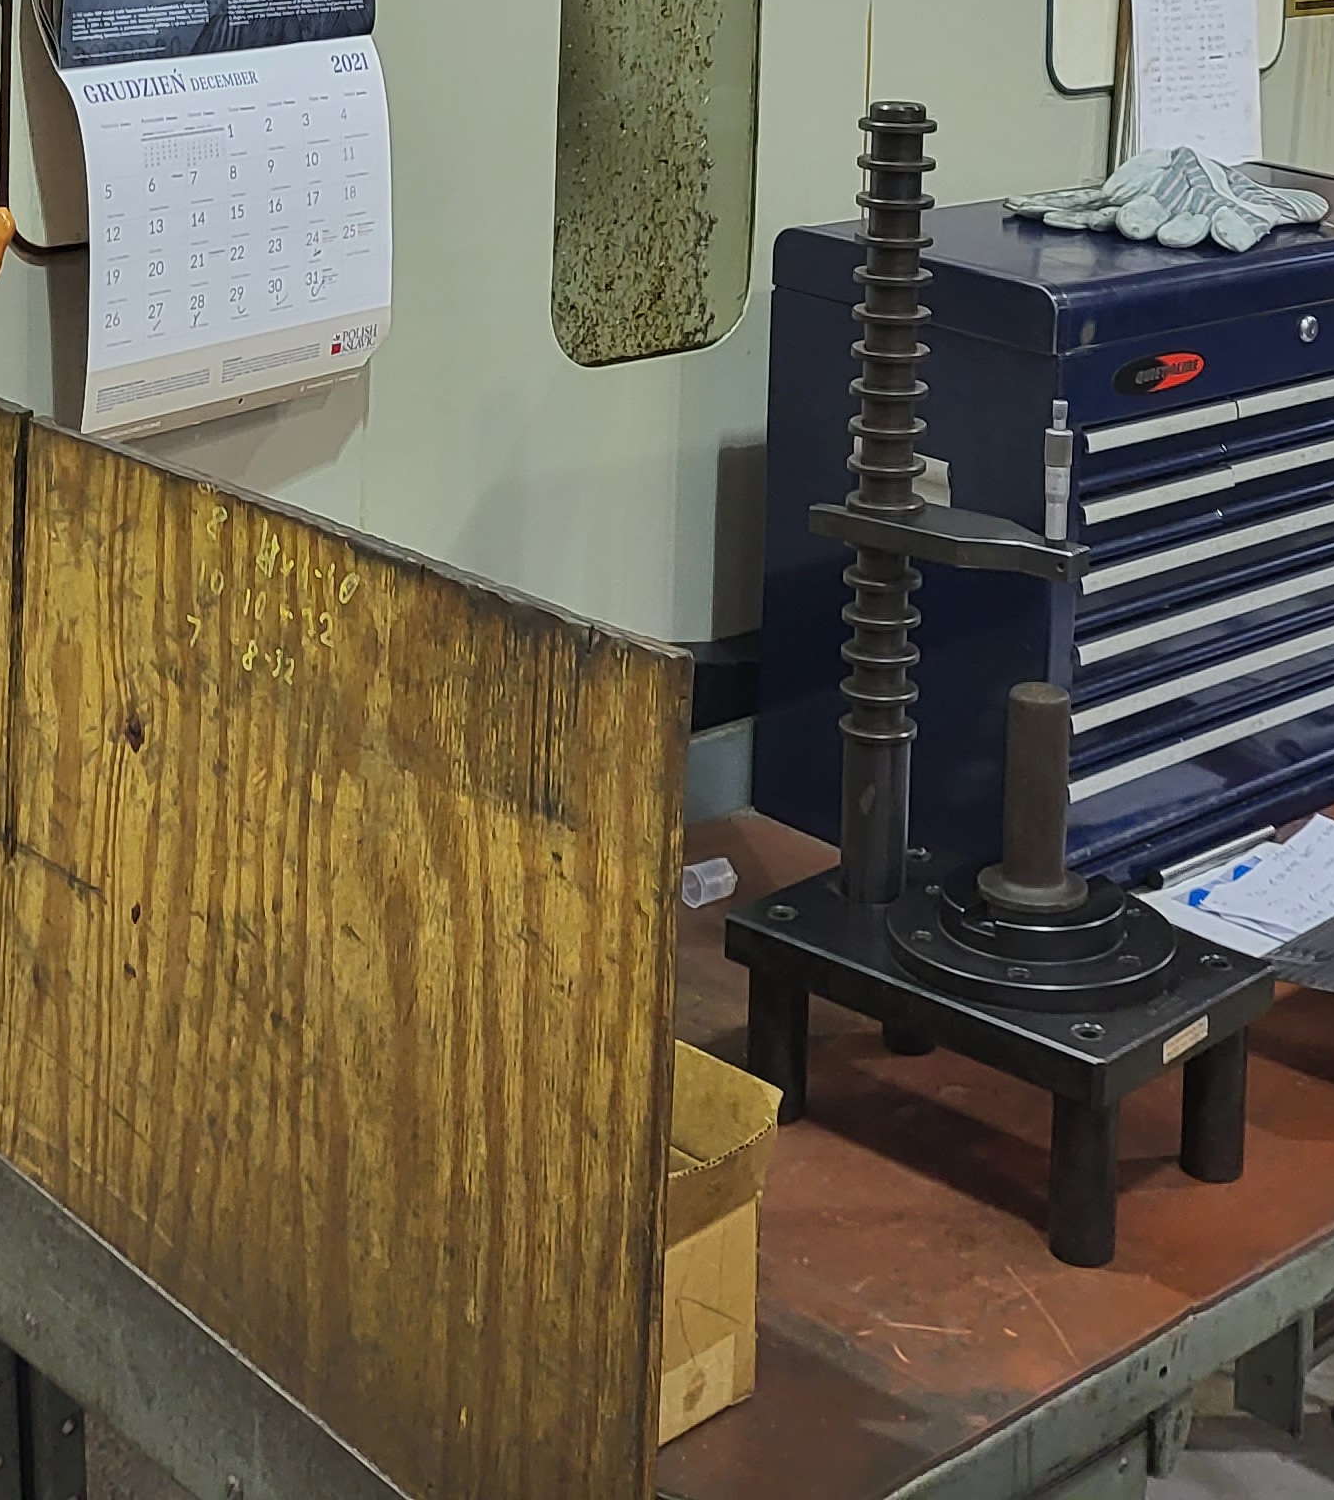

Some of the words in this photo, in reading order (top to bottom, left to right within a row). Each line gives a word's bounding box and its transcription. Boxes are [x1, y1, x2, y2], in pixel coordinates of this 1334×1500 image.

[83, 68, 186, 105] GRUDZIEŃ
[190, 70, 260, 92] DECEMBER
[330, 51, 370, 74] 2021
[227, 124, 234, 139] 1
[265, 117, 273, 132] 2
[302, 112, 310, 127] 3
[340, 108, 347, 121] 4
[105, 184, 113, 200] 5
[148, 177, 156, 193] 6
[190, 170, 198, 185] 7
[229, 165, 237, 180] 8
[267, 159, 275, 174] 9
[306, 151, 319, 167] 10
[105, 226, 121, 243] 12
[149, 218, 164, 235] 13
[191, 211, 205, 228] 14
[230, 204, 245, 220] 15
[268, 197, 283, 214] 16
[306, 190, 320, 206] 17
[344, 185, 357, 200] 18
[106, 269, 121, 286] 19
[148, 260, 164, 277] 20
[190, 253, 205, 269] 21
[230, 245, 245, 261] 22
[268, 238, 282, 254] 23
[306, 231, 319, 246] 24
[342, 224, 356, 240] 25
[104, 312, 121, 329] 26
[148, 302, 164, 320] 27
[190, 294, 205, 311] 28
[229, 286, 244, 302] 29
[268, 278, 283, 294] 30
[305, 271, 319, 286] 31
